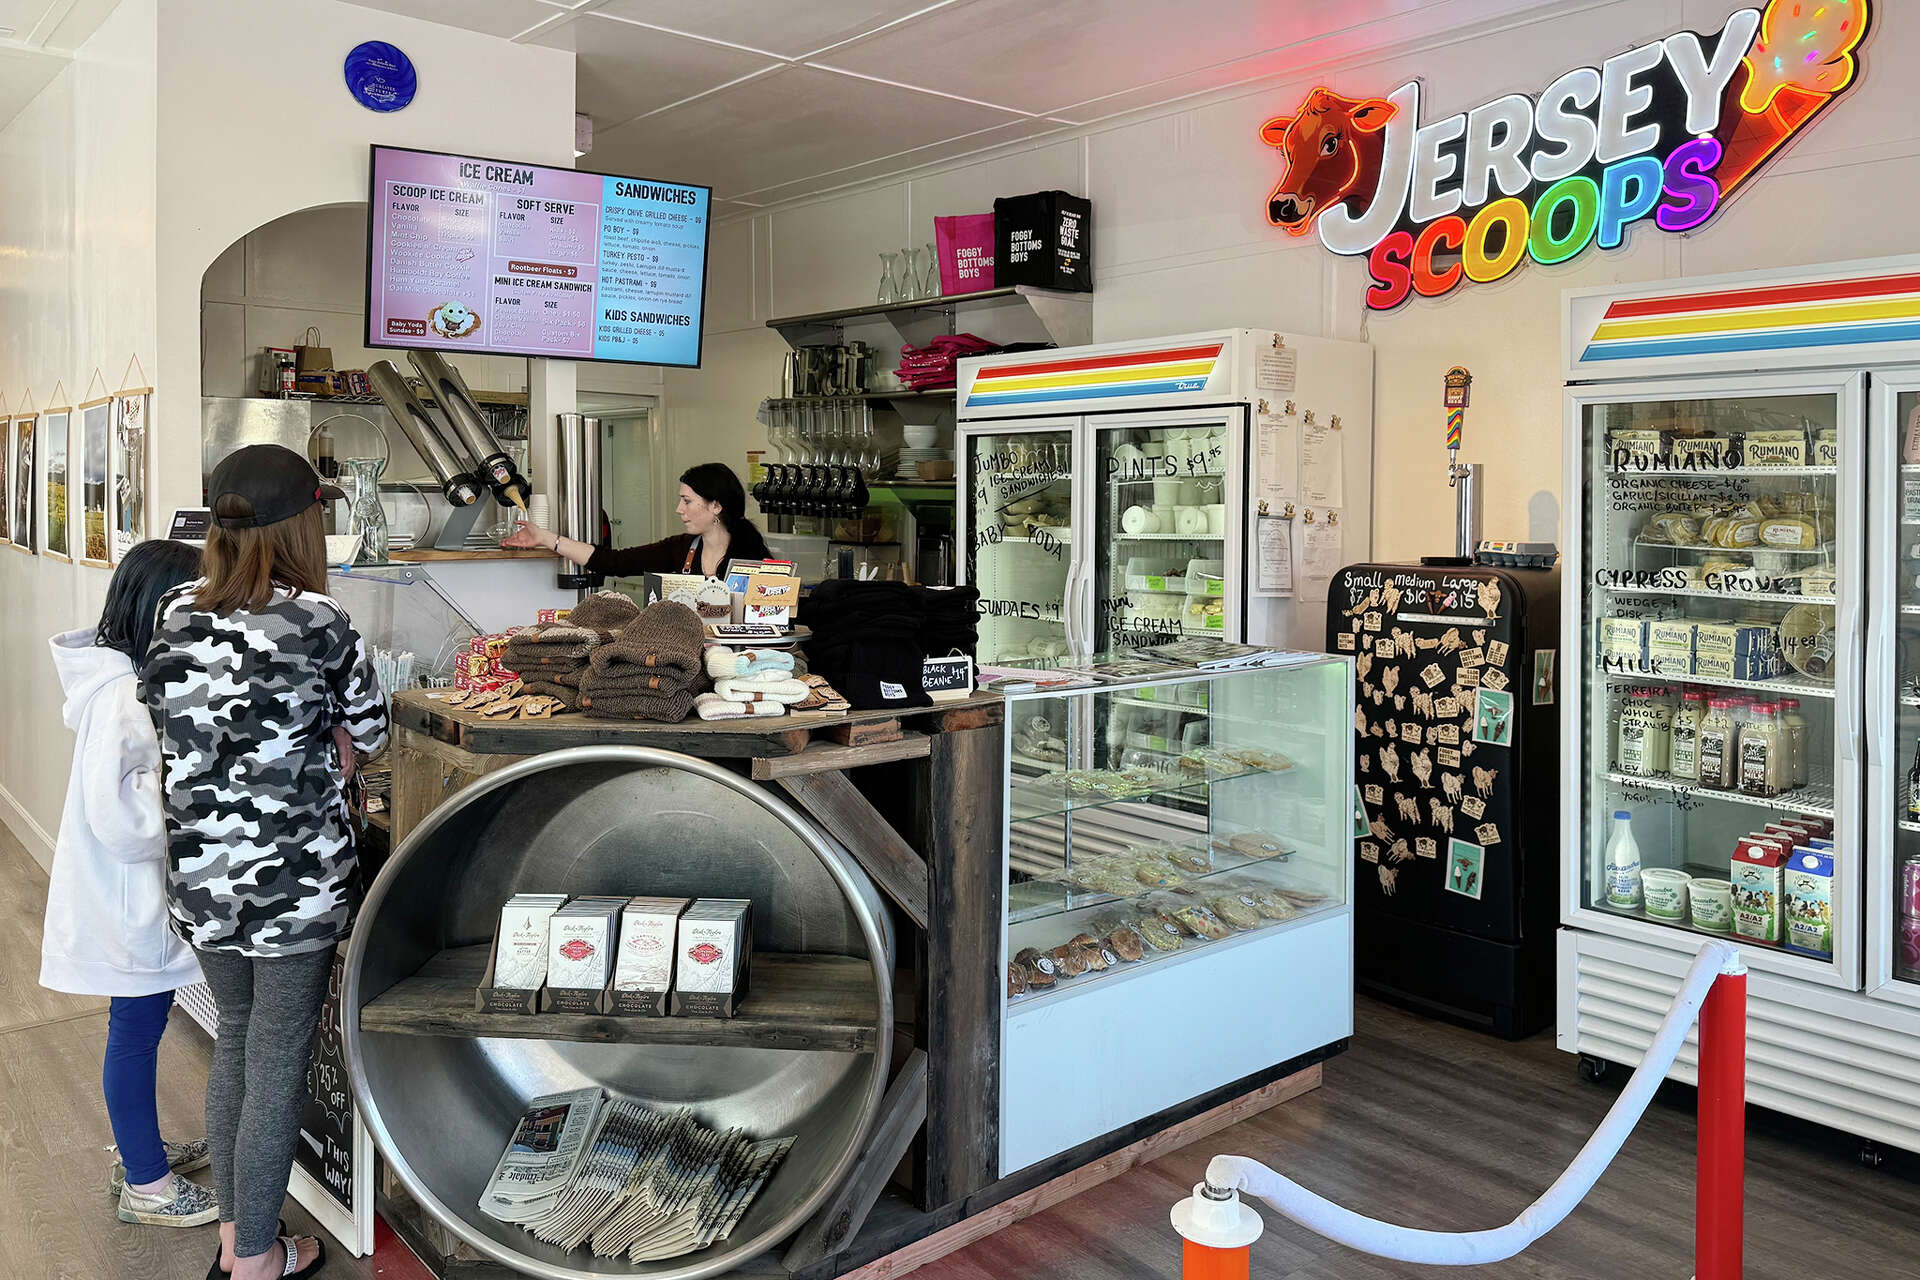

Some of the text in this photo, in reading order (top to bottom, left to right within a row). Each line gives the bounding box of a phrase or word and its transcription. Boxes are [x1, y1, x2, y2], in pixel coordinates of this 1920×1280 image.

[1318, 8, 1761, 256] JERSEY
[486, 166, 534, 186] CREAM
[393, 184, 484, 205] SCOOP ICE CREAM
[392, 202, 420, 212] FLAVOR
[454, 208, 470, 217] SIZE
[516, 199, 575, 215] SOFT SERVE
[500, 212, 526, 222] FLAVOR
[550, 216, 564, 224] SIZE
[605, 206, 625, 215] CRISPY
[668, 212, 688, 222] CHEESE
[1062, 216, 1077, 228] ZERO
[1366, 137, 1723, 310] SCOOPS
[604, 224, 612, 232] PO
[612, 226, 625, 234] BOY
[1059, 226, 1080, 239] WASTE
[1010, 230, 1033, 242] FOGGY
[1060, 236, 1076, 248] GOAL
[1010, 240, 1042, 252] BOTTOMS
[603, 250, 625, 259] TURKEY
[626, 252, 644, 262] PESTO
[956, 247, 982, 258] FOGGY
[1010, 252, 1028, 263] BOYS
[958, 256, 994, 269] BOTTOMS
[510, 263, 542, 273] Rootbeer
[542, 266, 562, 275] Floats
[959, 268, 980, 279] BOYS
[494, 276, 592, 293] MINI ICE CREAM SANDWICH
[602, 276, 613, 284] HOT
[614, 278, 643, 288] PASTRAMI
[495, 296, 521, 306] FLAVOR
[544, 301, 558, 309] SIZE
[605, 308, 628, 322] KIDS
[389, 326, 412, 335] Sundae
[391, 320, 407, 329] Baby
[598, 325, 611, 333] KIDS
[1616, 440, 1654, 455] RUMIANO
[1678, 438, 1722, 454] RUMIANO
[1749, 444, 1800, 460] RUMIANO
[1613, 448, 1742, 472] RUMIANO
[990, 459, 1050, 488] ICE CREAM
[1611, 478, 1666, 489] ORGANIC
[1612, 502, 1663, 512] ORGANIC
[974, 522, 1064, 562] BABY YODA
[1344, 571, 1384, 588] Small
[1442, 575, 1478, 596] Large
[1595, 568, 1786, 594] CYPRESS GROVE
[1350, 588, 1364, 606] $7
[1450, 591, 1476, 609] $15
[1614, 598, 1658, 607] WEDGE
[978, 600, 1040, 620] SUNDAES
[1616, 608, 1644, 619] DISK
[1105, 616, 1184, 636] ICE CREAM
[1605, 624, 1637, 639] RUMIANO
[1654, 628, 1688, 643] RUMIANO
[1698, 630, 1732, 646] RUMIANO
[1602, 656, 1663, 674] MILK
[1652, 654, 1687, 669] RUMIANO
[1696, 656, 1730, 671] RUMIANO
[922, 664, 946, 674] BLACK
[922, 676, 953, 688] BEANIE
[1606, 682, 1671, 697] FERREIRA
[1622, 698, 1652, 708] CHOC
[1622, 710, 1663, 719] WHOLE
[1674, 752, 1693, 760] MILK
[1702, 764, 1720, 774] MILK
[1744, 772, 1764, 781] MILK
[1740, 912, 1763, 922] A2/A2
[1794, 922, 1818, 933] A2/A2
[320, 1063, 338, 1092] 25%
[330, 1091, 346, 1110] OFF
[325, 1134, 350, 1172] THIS
[324, 1161, 352, 1205] WAY!
